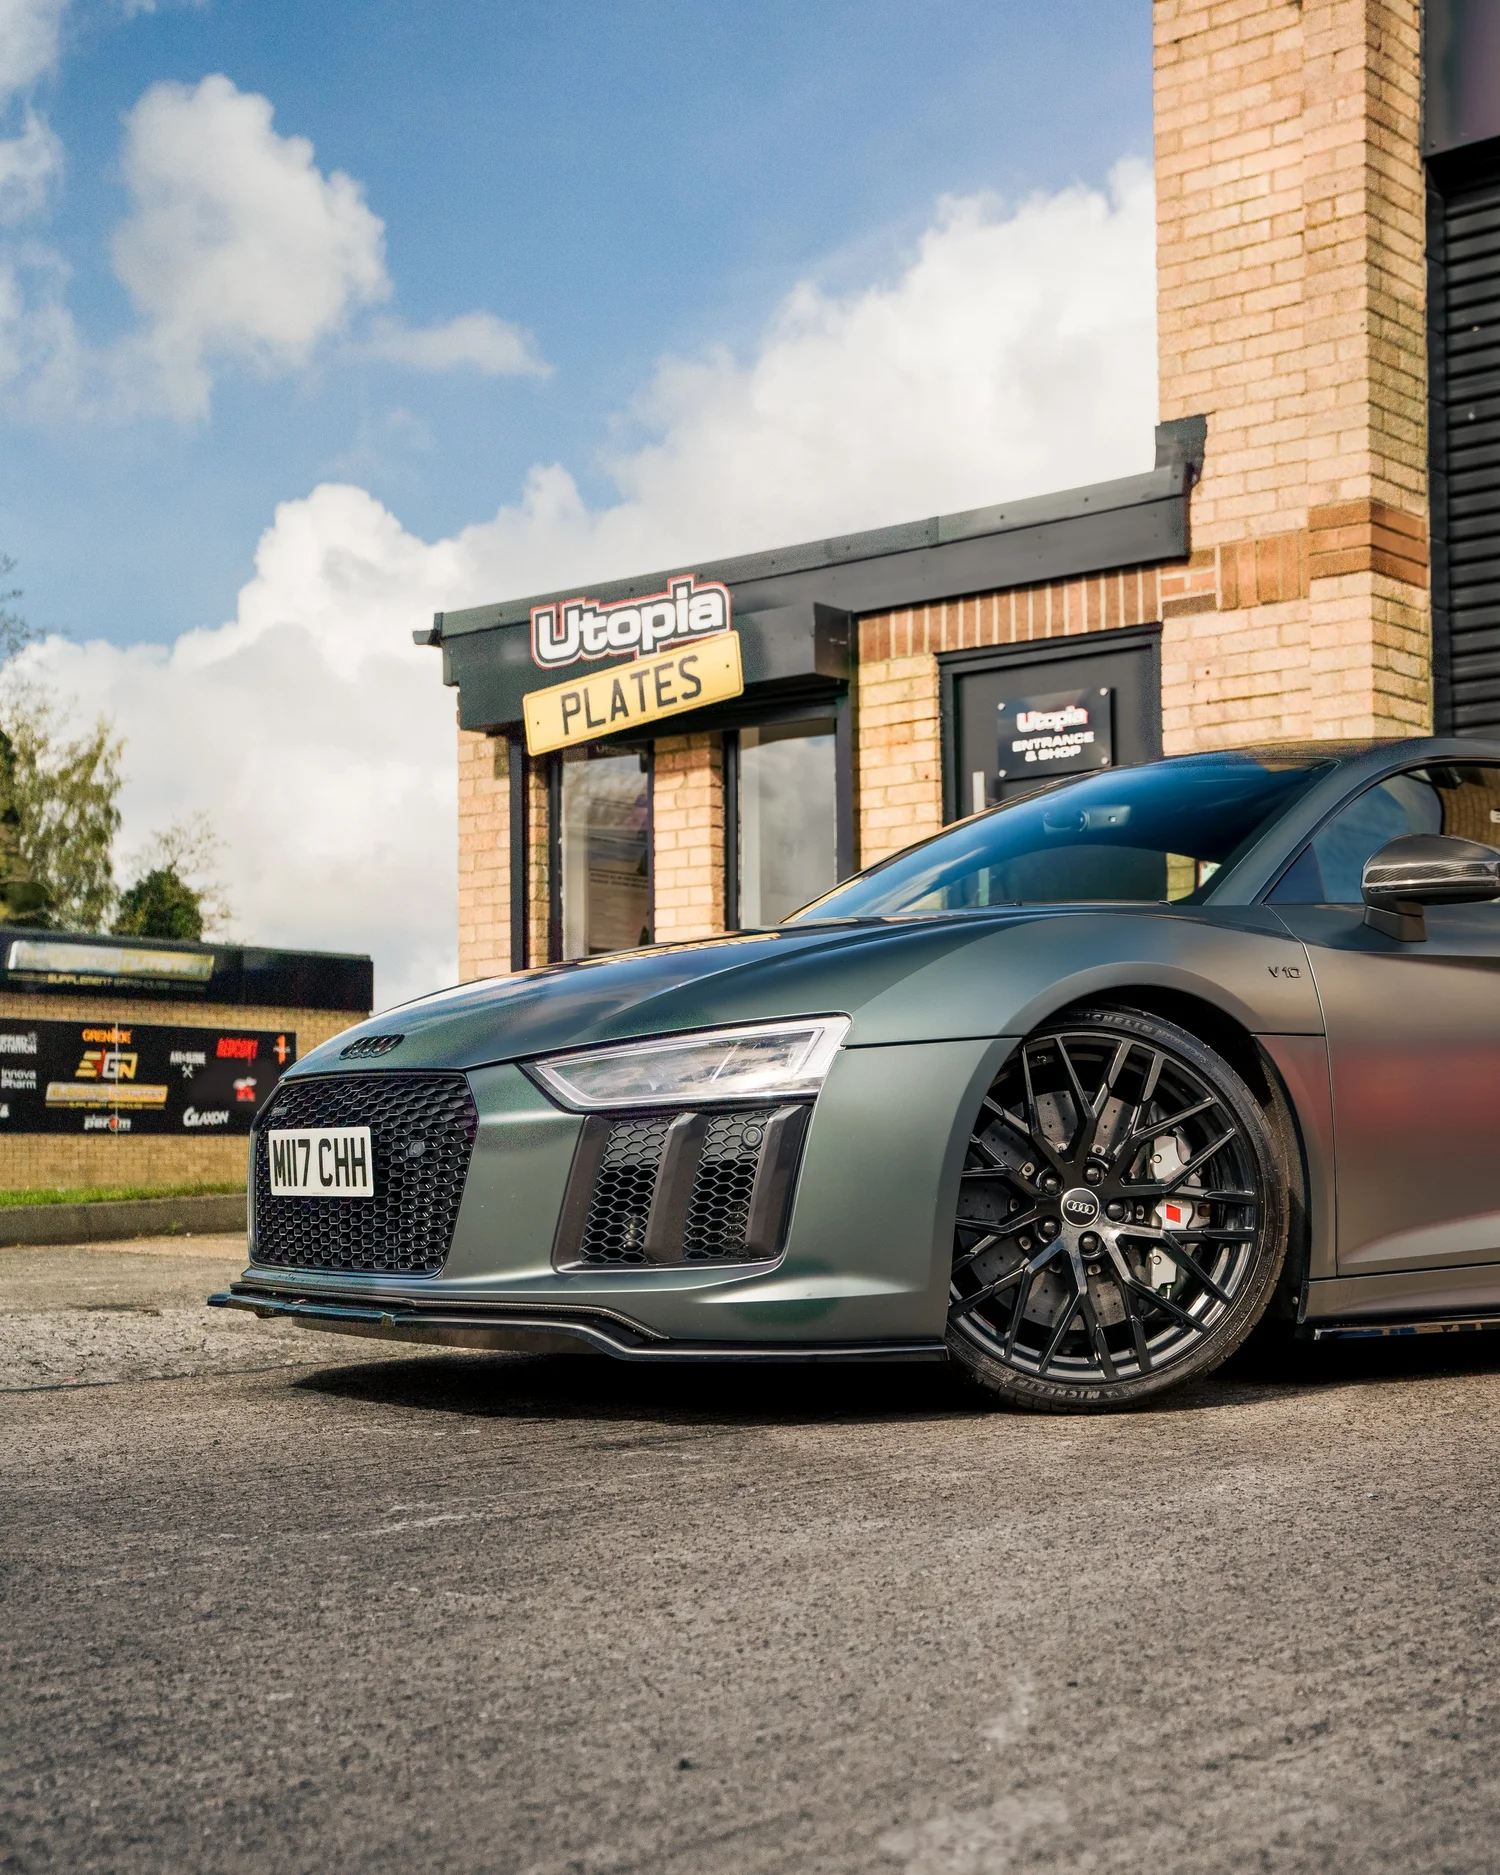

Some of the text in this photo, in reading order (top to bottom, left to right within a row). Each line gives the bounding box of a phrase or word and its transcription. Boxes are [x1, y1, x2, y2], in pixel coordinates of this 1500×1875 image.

[534, 578, 728, 665] Utopia
[560, 655, 703, 736] PLATES
[1016, 705, 1088, 733] Utopia
[1012, 731, 1094, 752] ENTRANCE
[1025, 745, 1081, 762] & SHOP
[1267, 966, 1302, 979] V10
[318, 1136, 368, 1187] CHH
